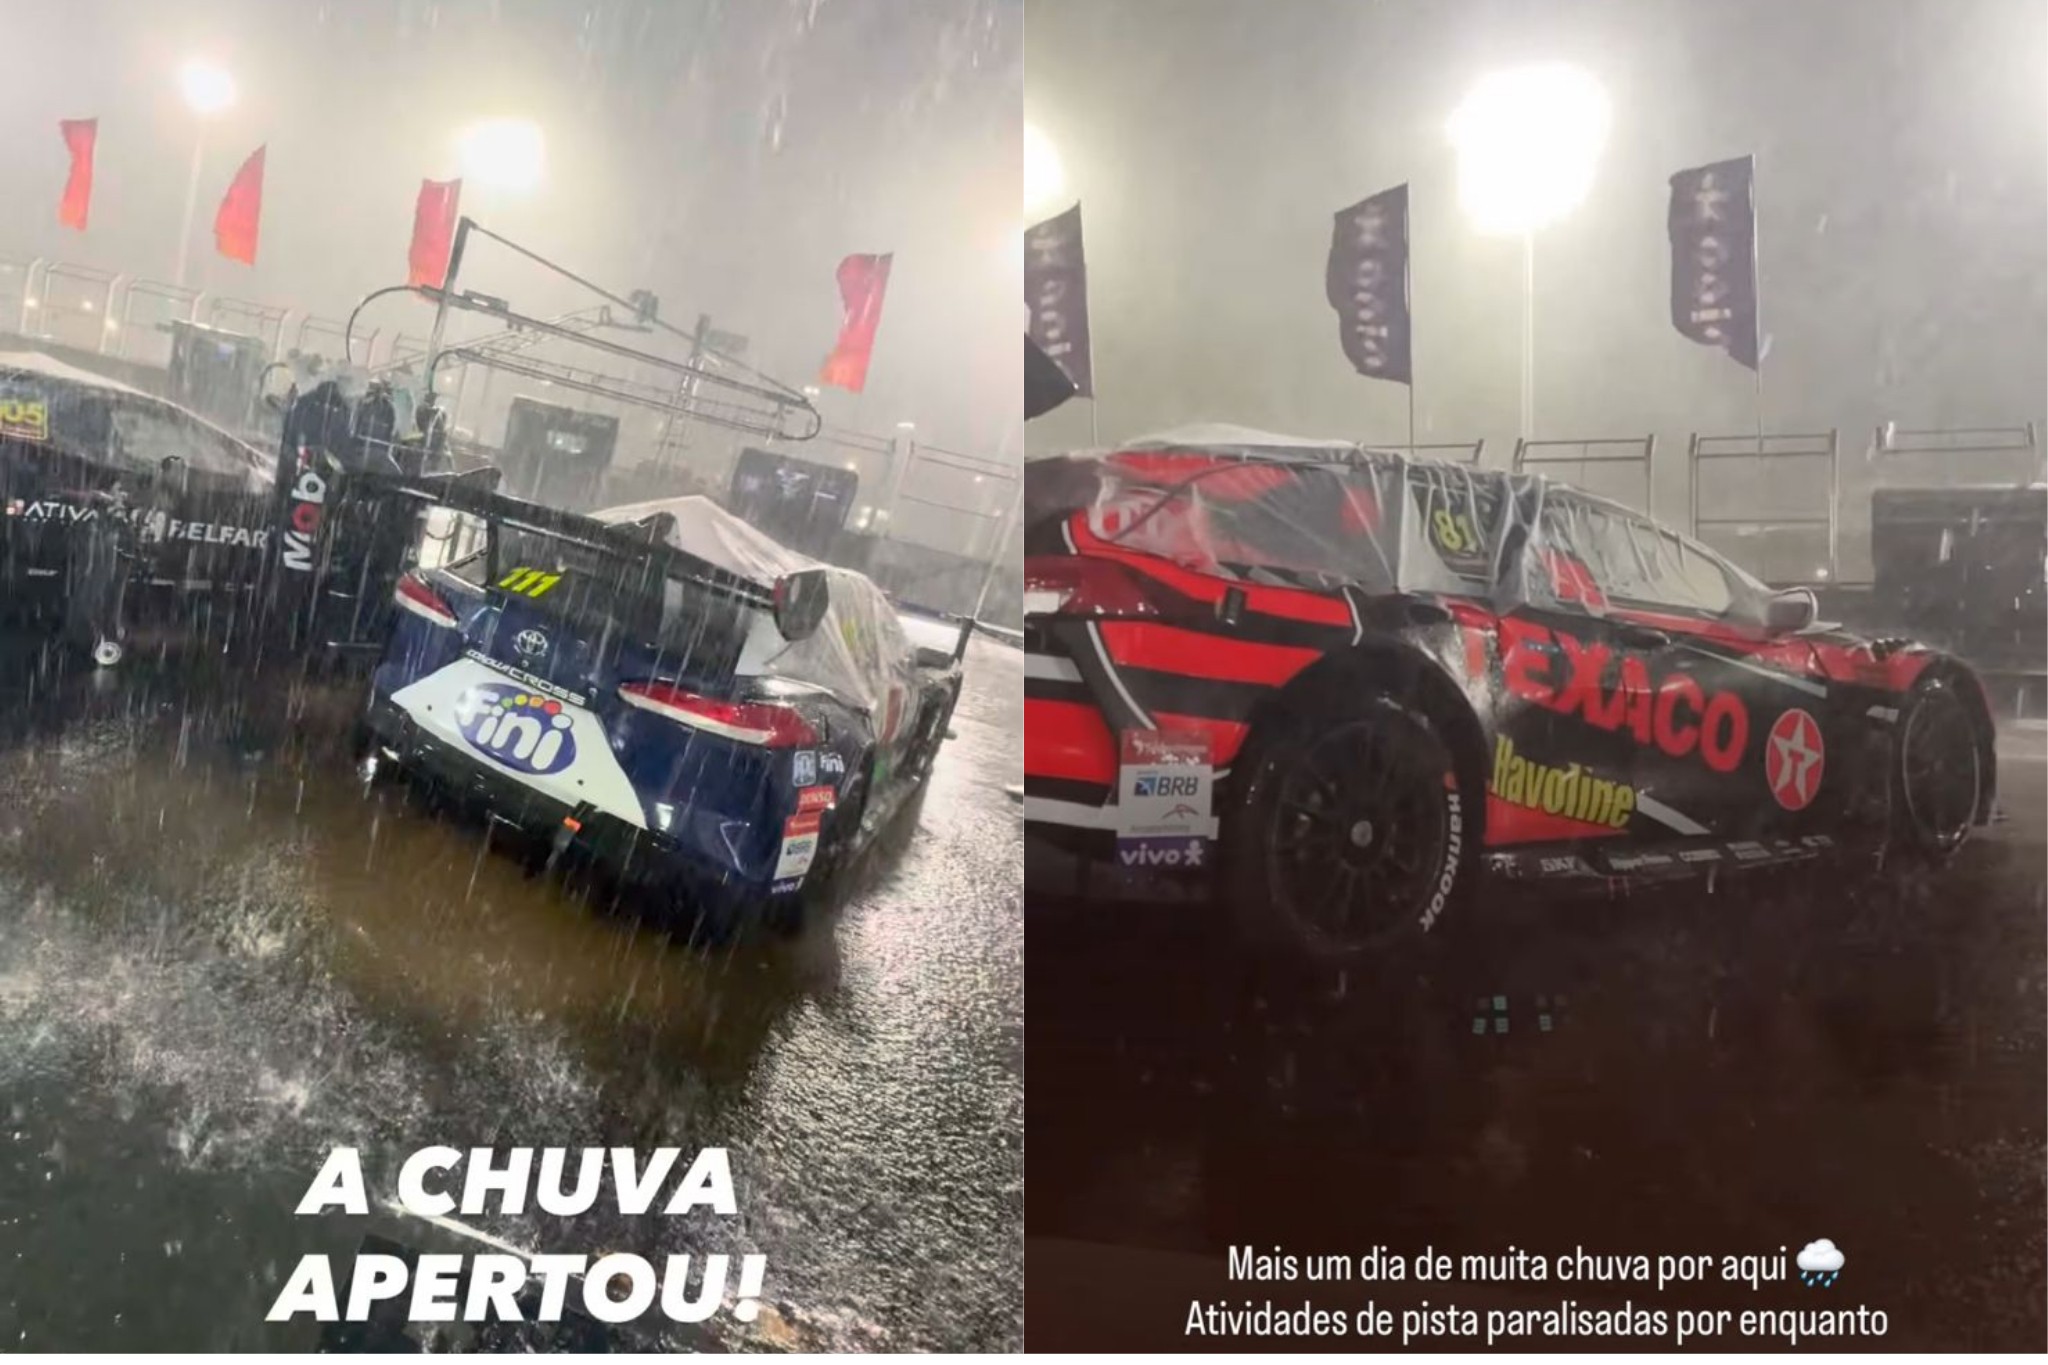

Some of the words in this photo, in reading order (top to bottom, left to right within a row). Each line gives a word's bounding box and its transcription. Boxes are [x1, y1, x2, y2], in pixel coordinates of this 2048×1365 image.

[283, 446, 326, 571] Mob
[498, 567, 561, 598] 111
[508, 667, 586, 706] CROSS
[1453, 604, 1749, 772] TEXACO
[1157, 776, 1199, 796] BRB
[1491, 733, 1637, 829] Havoline
[1120, 843, 1181, 866] vivo
[1418, 792, 1462, 933] Hankook
